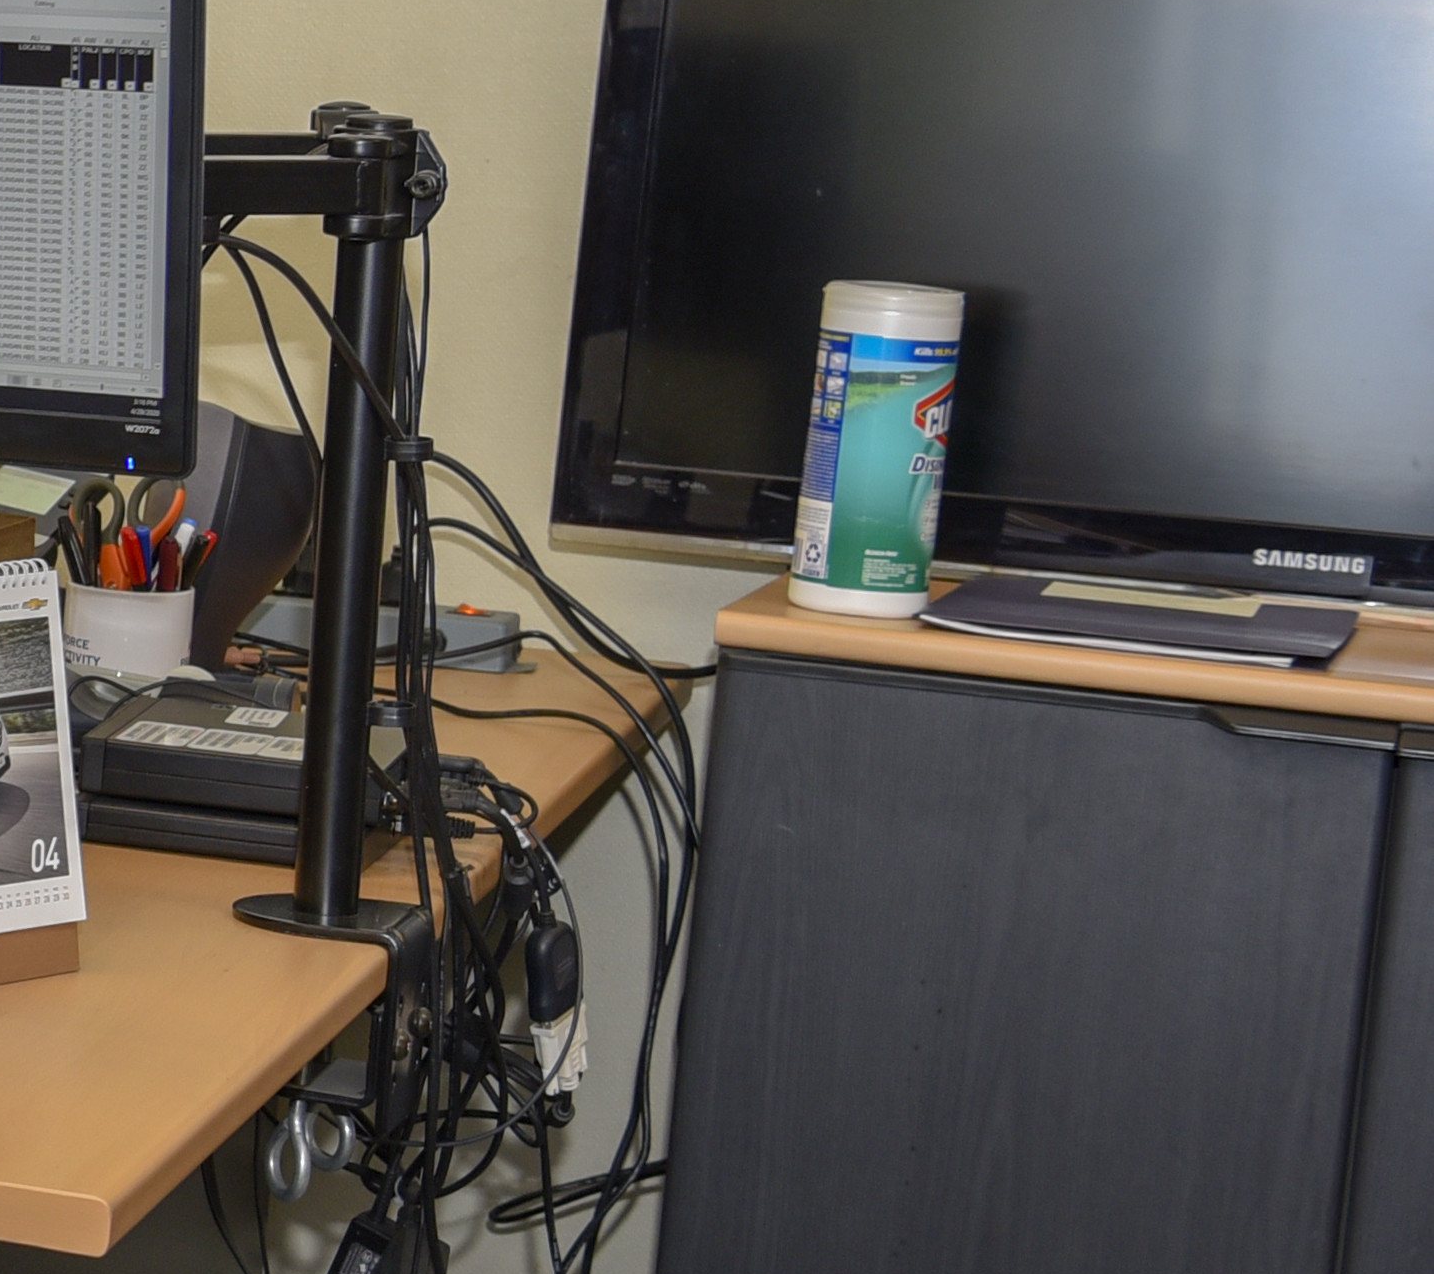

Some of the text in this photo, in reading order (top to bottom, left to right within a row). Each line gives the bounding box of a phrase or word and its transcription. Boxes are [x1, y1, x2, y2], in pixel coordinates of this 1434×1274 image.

[1252, 547, 1365, 575] SAMSUNG
[64, 635, 90, 650] ORCE
[31, 837, 61, 873] 04
